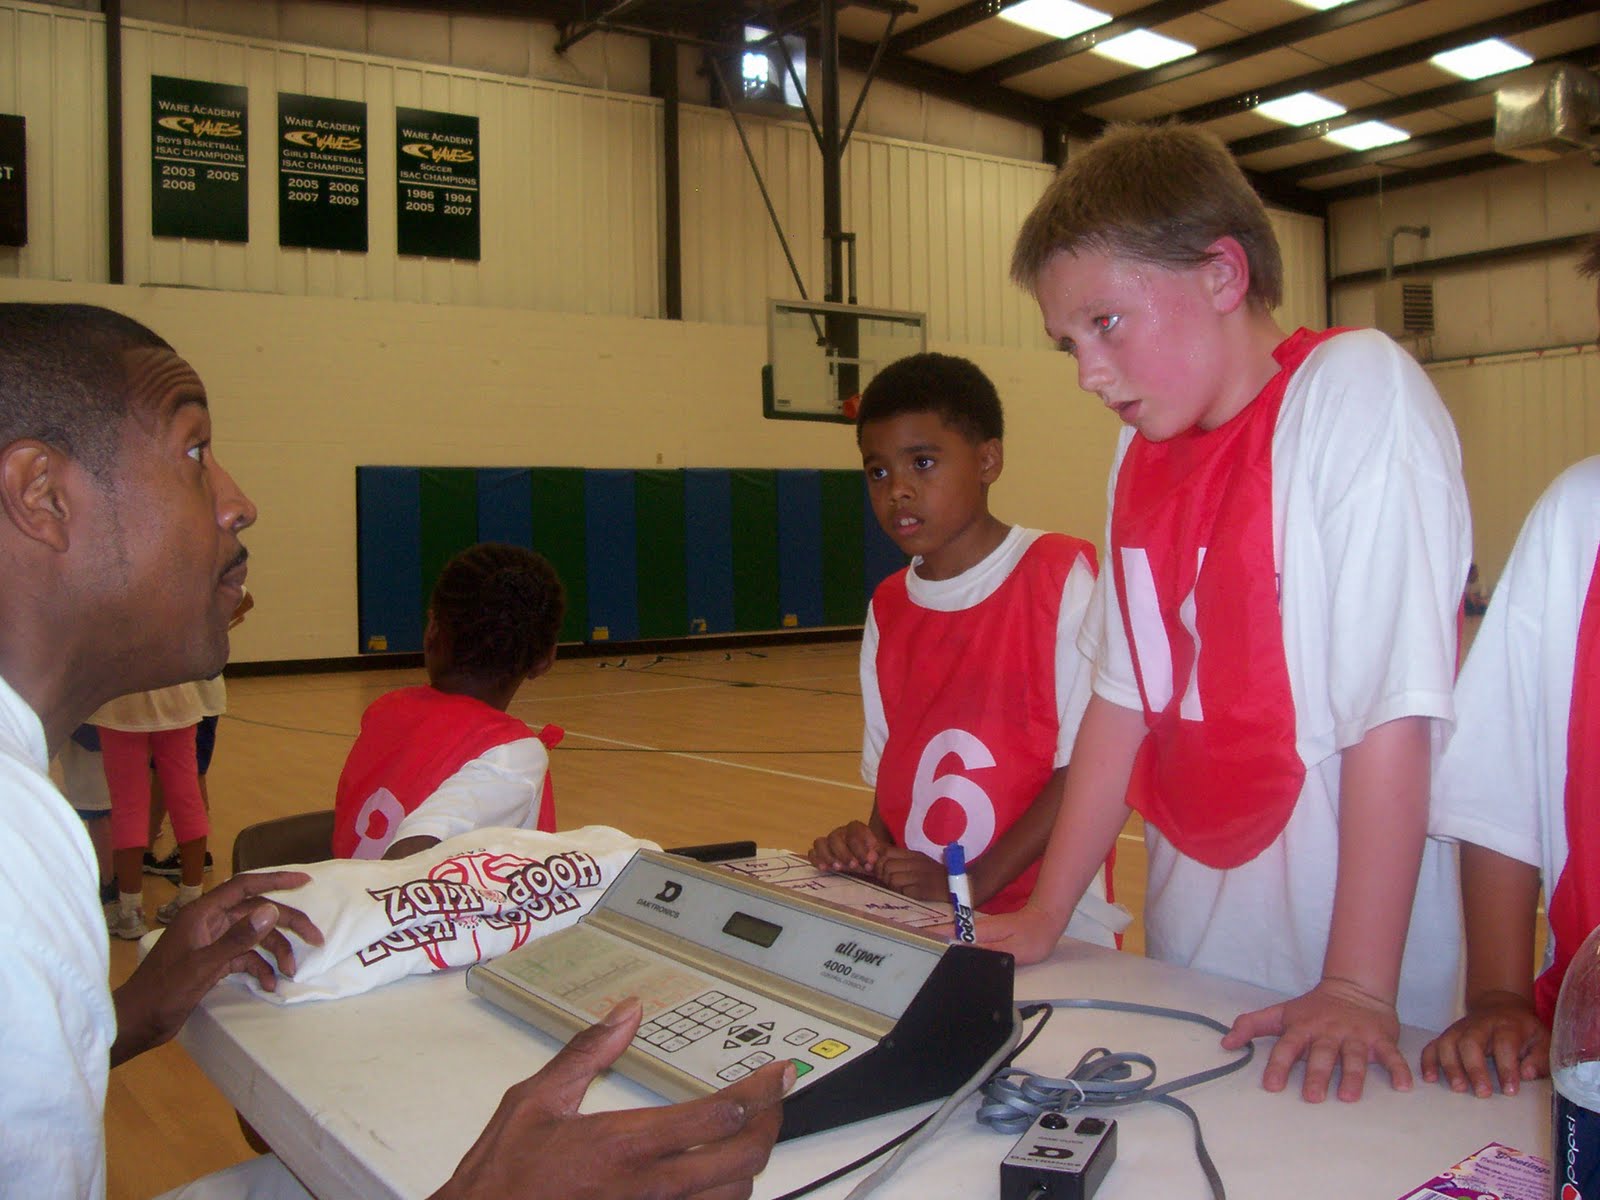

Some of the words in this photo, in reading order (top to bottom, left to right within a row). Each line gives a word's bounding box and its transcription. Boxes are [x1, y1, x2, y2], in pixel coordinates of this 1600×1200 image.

[158, 101, 190, 113] WARE
[192, 104, 242, 118] ACADEMY
[284, 115, 314, 127] WARE
[316, 119, 361, 133] ACADEMY
[156, 135, 182, 145] BOYS
[183, 138, 241, 151] BASKETBALL
[402, 129, 430, 141] WARE
[431, 132, 473, 146] ACADEMY
[156, 146, 180, 156] ISAC
[182, 149, 245, 161] CHAMPIONS
[283, 149, 309, 159] GIRLS
[310, 152, 363, 165] BASKETBALL
[162, 165, 196, 177] 2003
[206, 169, 239, 181] 2005
[282, 159, 305, 168] ISAC
[306, 161, 364, 175] CHAMPIONS
[420, 162, 453, 173] SOCCER
[162, 179, 196, 191] 2008
[288, 178, 319, 190] 2005
[329, 181, 359, 193] 2006
[400, 170, 421, 180] ISAC
[422, 173, 477, 186] CHAMPIONS
[288, 191, 319, 202] 2007
[329, 194, 359, 206] 2009
[407, 189, 435, 200] 1986
[444, 193, 472, 204] 1994
[406, 201, 435, 213] 2005
[443, 205, 472, 216] 2007
[905, 728, 997, 866] 6
[504, 850, 602, 906] HOOP
[366, 878, 486, 926] KIDZ
[636, 898, 681, 919] DAKTRONICS
[956, 904, 975, 942] EXPO
[823, 960, 853, 976] 4000
[1567, 1114, 1580, 1185] pepsi
